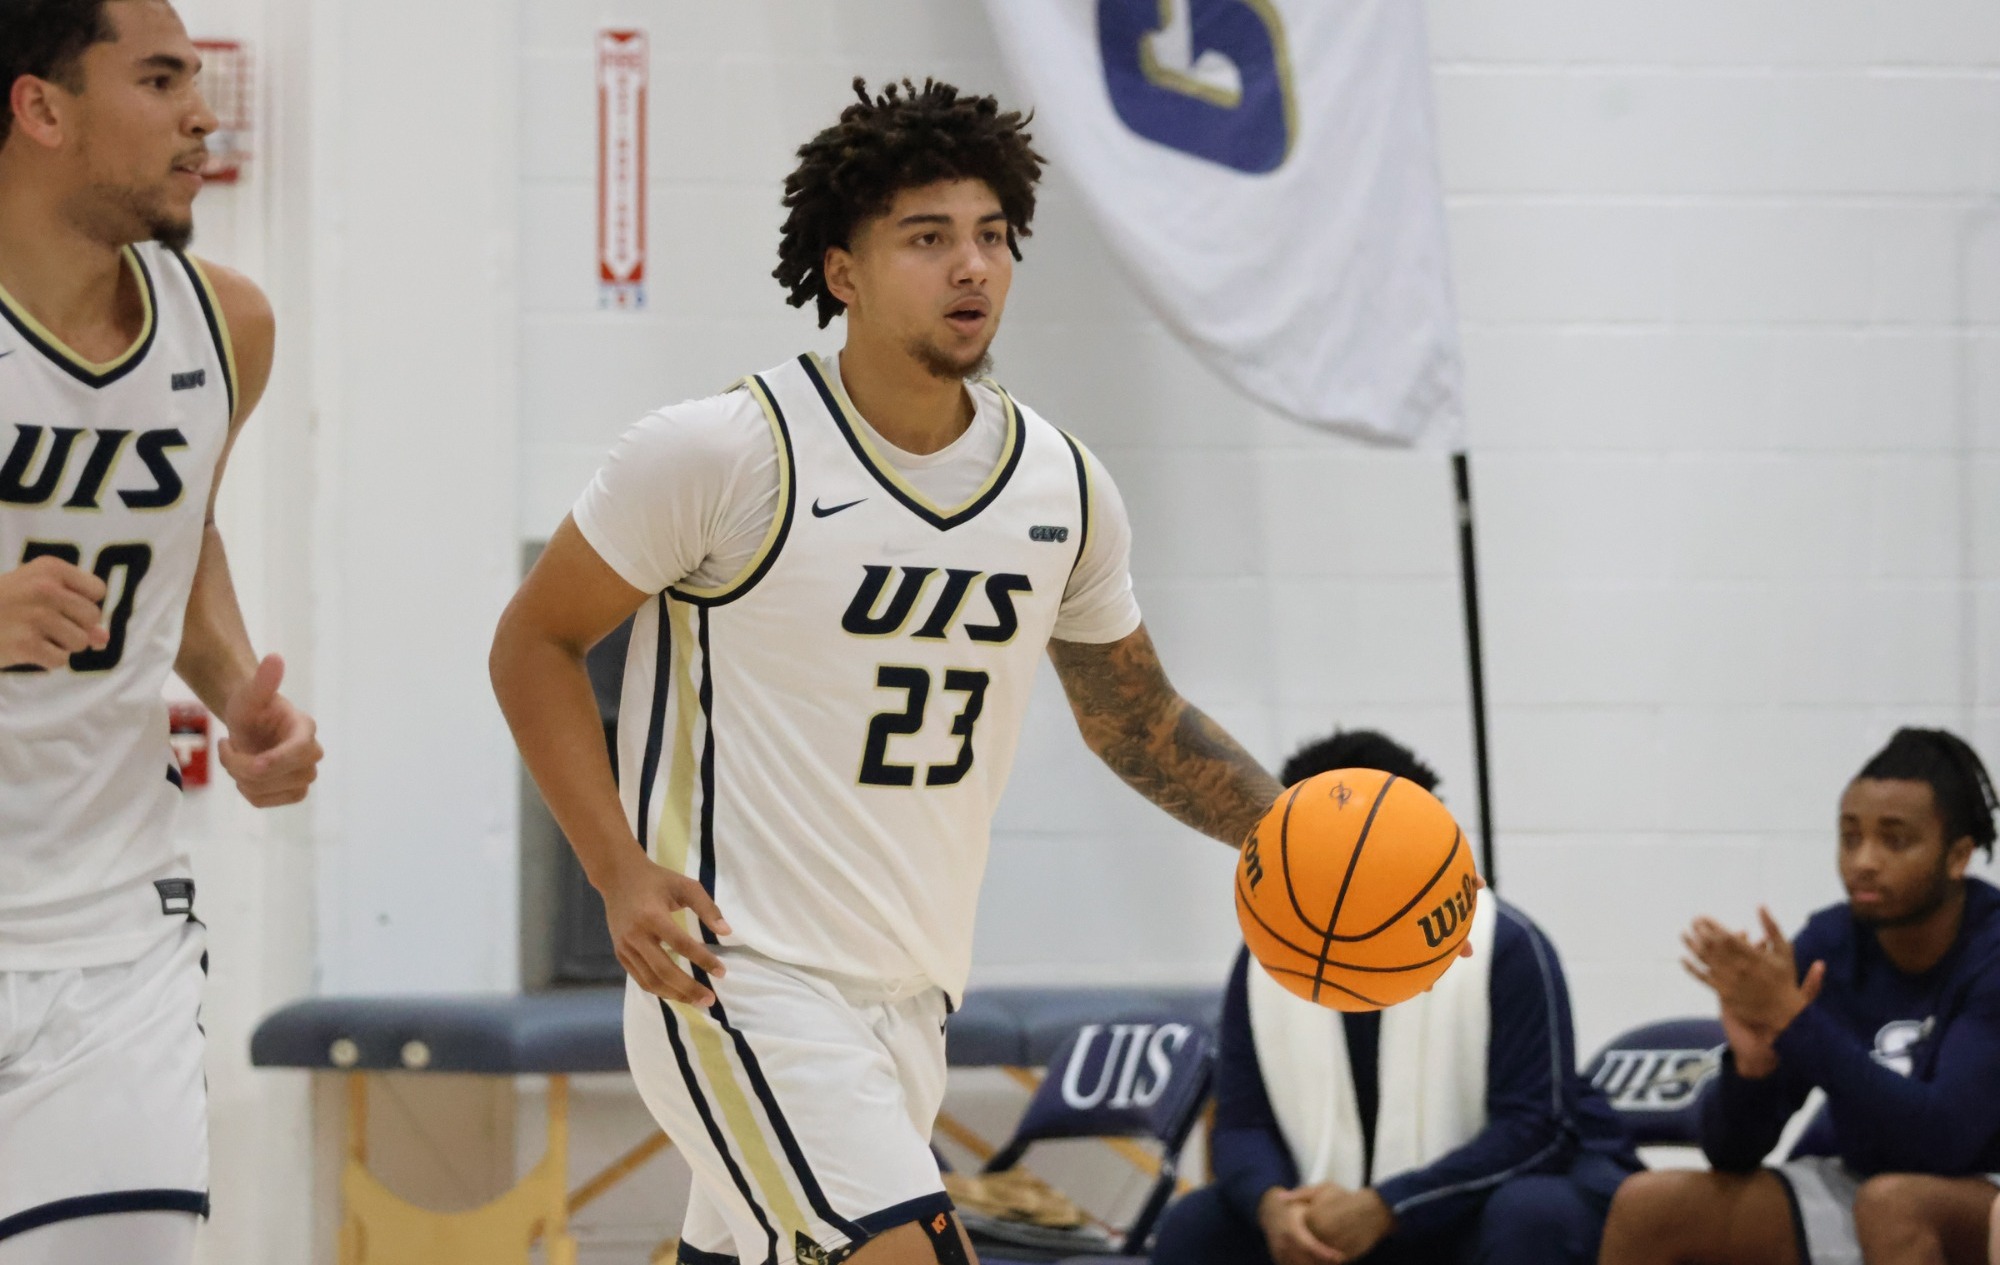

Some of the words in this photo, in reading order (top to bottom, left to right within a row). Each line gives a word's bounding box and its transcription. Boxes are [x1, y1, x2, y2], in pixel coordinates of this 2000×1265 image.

[0, 422, 189, 510] UIS
[841, 564, 1034, 647] UIS
[856, 661, 990, 788] 23
[1417, 873, 1478, 948] Wil
[1062, 1022, 1193, 1110] UIS
